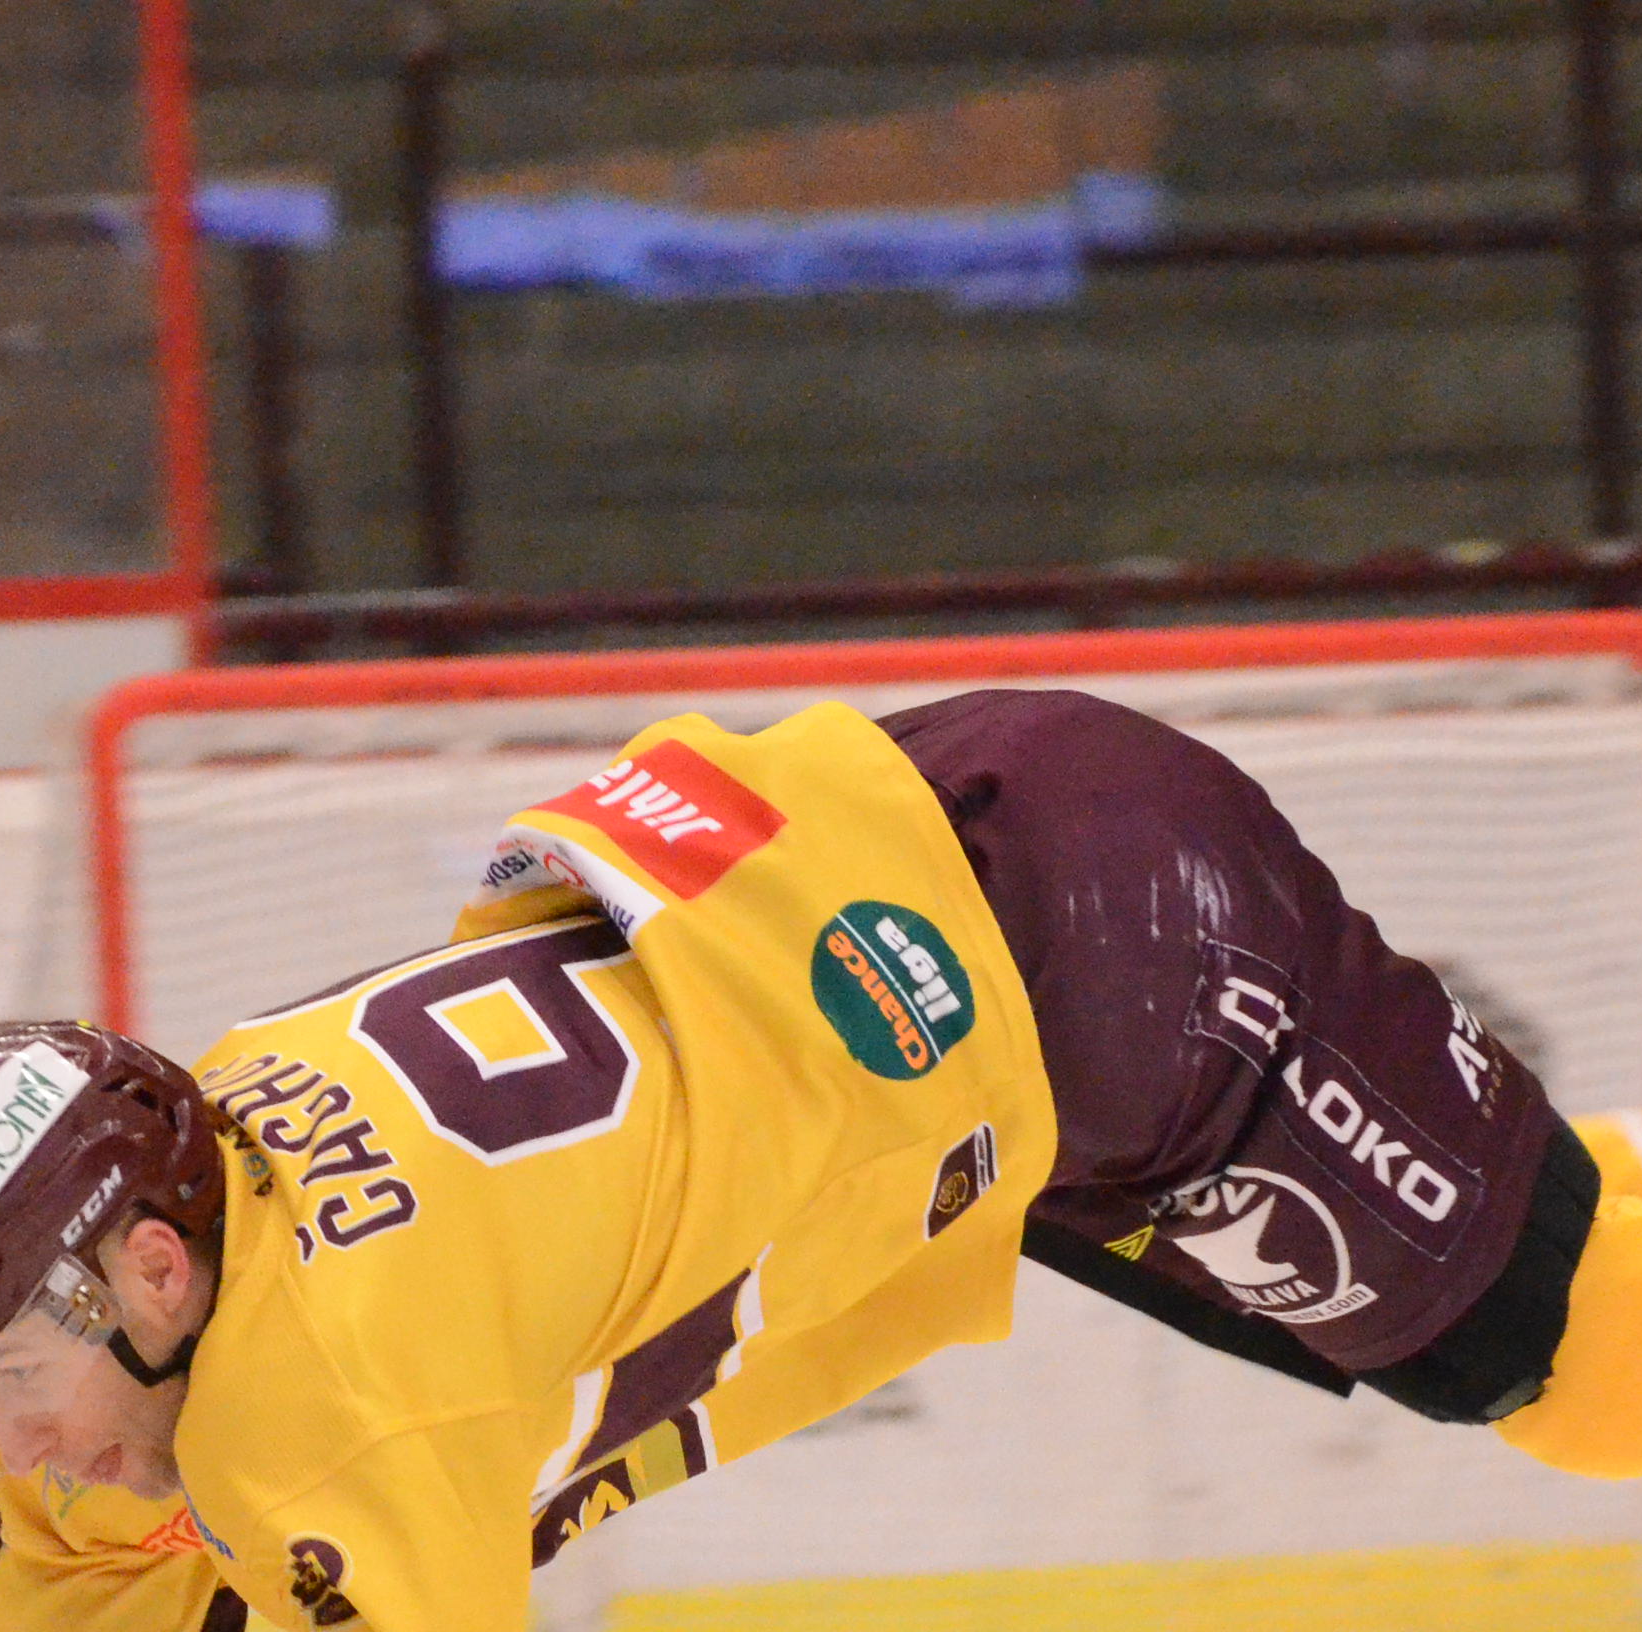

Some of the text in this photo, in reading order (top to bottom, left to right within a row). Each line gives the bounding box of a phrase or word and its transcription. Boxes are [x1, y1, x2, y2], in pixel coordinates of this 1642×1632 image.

[875, 915, 963, 1024] liga
[347, 912, 641, 1168] 9
[60, 1163, 126, 1248] CCM
